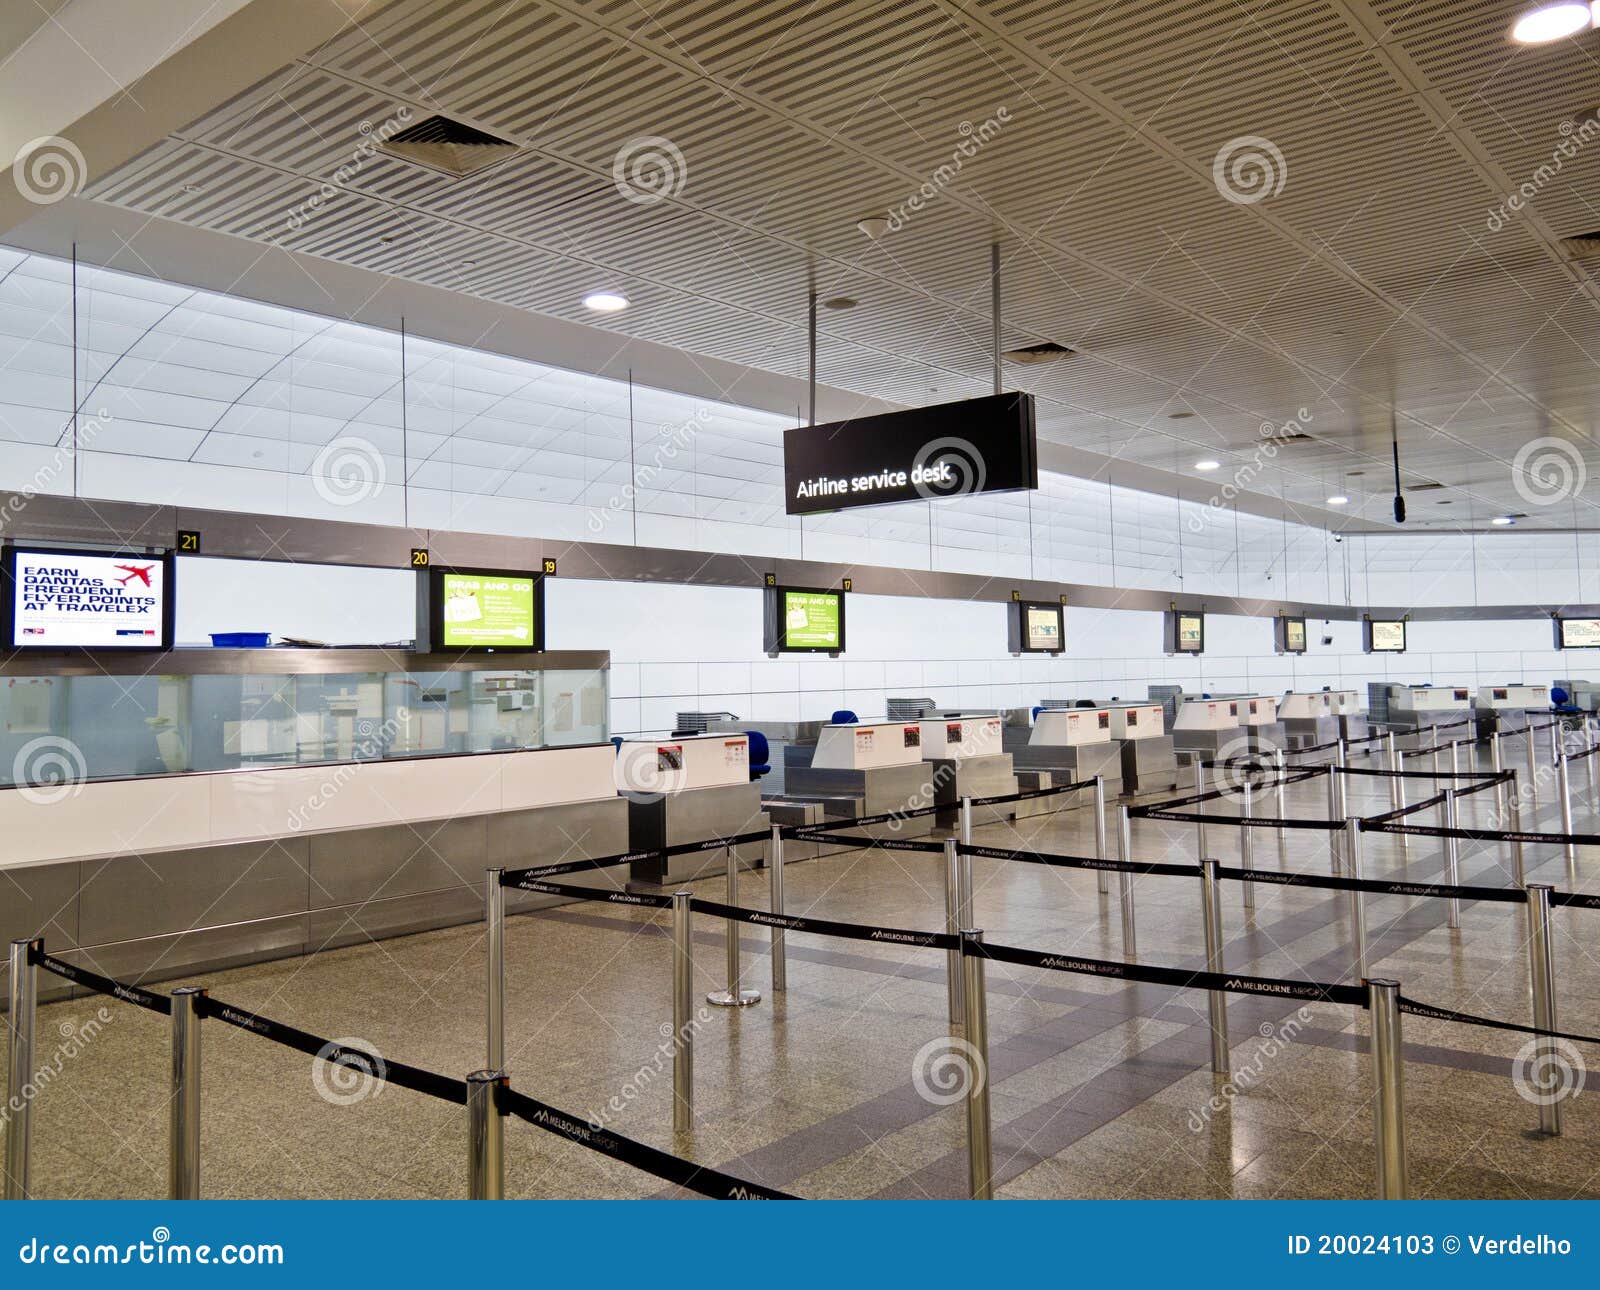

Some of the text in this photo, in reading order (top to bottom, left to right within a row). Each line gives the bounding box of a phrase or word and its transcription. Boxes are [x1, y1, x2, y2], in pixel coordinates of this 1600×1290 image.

[796, 461, 952, 499] Airline service desk
[181, 534, 198, 550] 21
[413, 552, 428, 565] 20
[24, 567, 79, 577] EARN
[544, 561, 555, 573] 19
[24, 576, 104, 587] QANTAS
[484, 582, 509, 592] AND
[512, 583, 530, 592] GO
[24, 585, 125, 596] FREQUENT
[24, 594, 156, 606] FLYER POINTS
[24, 602, 149, 614] AT TRAVELEX
[1056, 960, 1097, 972] MELBOURNE
[1243, 982, 1291, 994] MELBOURNE
[549, 1114, 591, 1141] MELBOURNE
